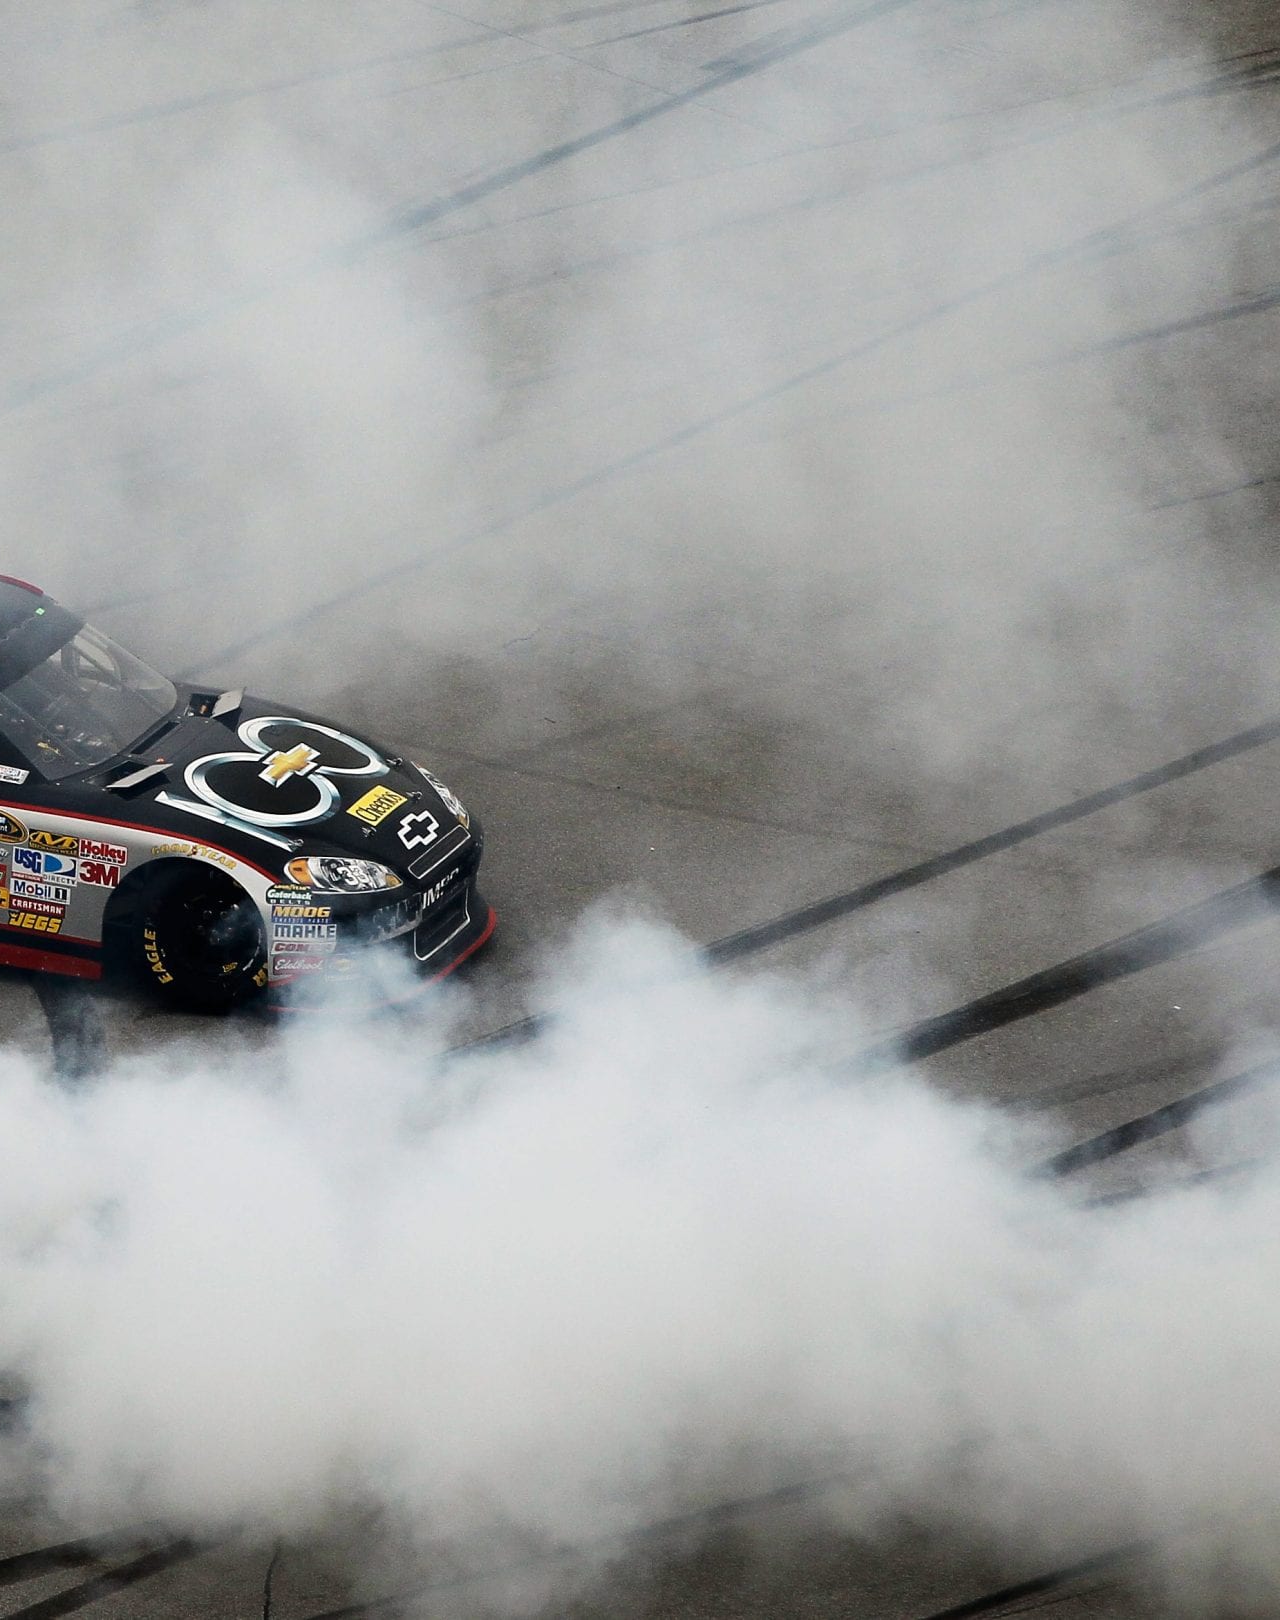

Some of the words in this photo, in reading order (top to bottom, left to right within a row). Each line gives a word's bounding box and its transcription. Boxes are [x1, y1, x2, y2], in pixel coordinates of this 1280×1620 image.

[80, 840, 125, 864] Holley
[14, 848, 42, 874] USG
[43, 874, 76, 885] DIRECTV
[80, 861, 119, 887] 3M
[14, 880, 51, 897] Mobil
[267, 889, 312, 900] Gatorback
[12, 899, 62, 914] CRAFTSMAN
[273, 906, 331, 918] MOOG
[9, 912, 62, 934] JEGS
[275, 925, 336, 938] MAHLE
[144, 928, 174, 984] EAGLE
